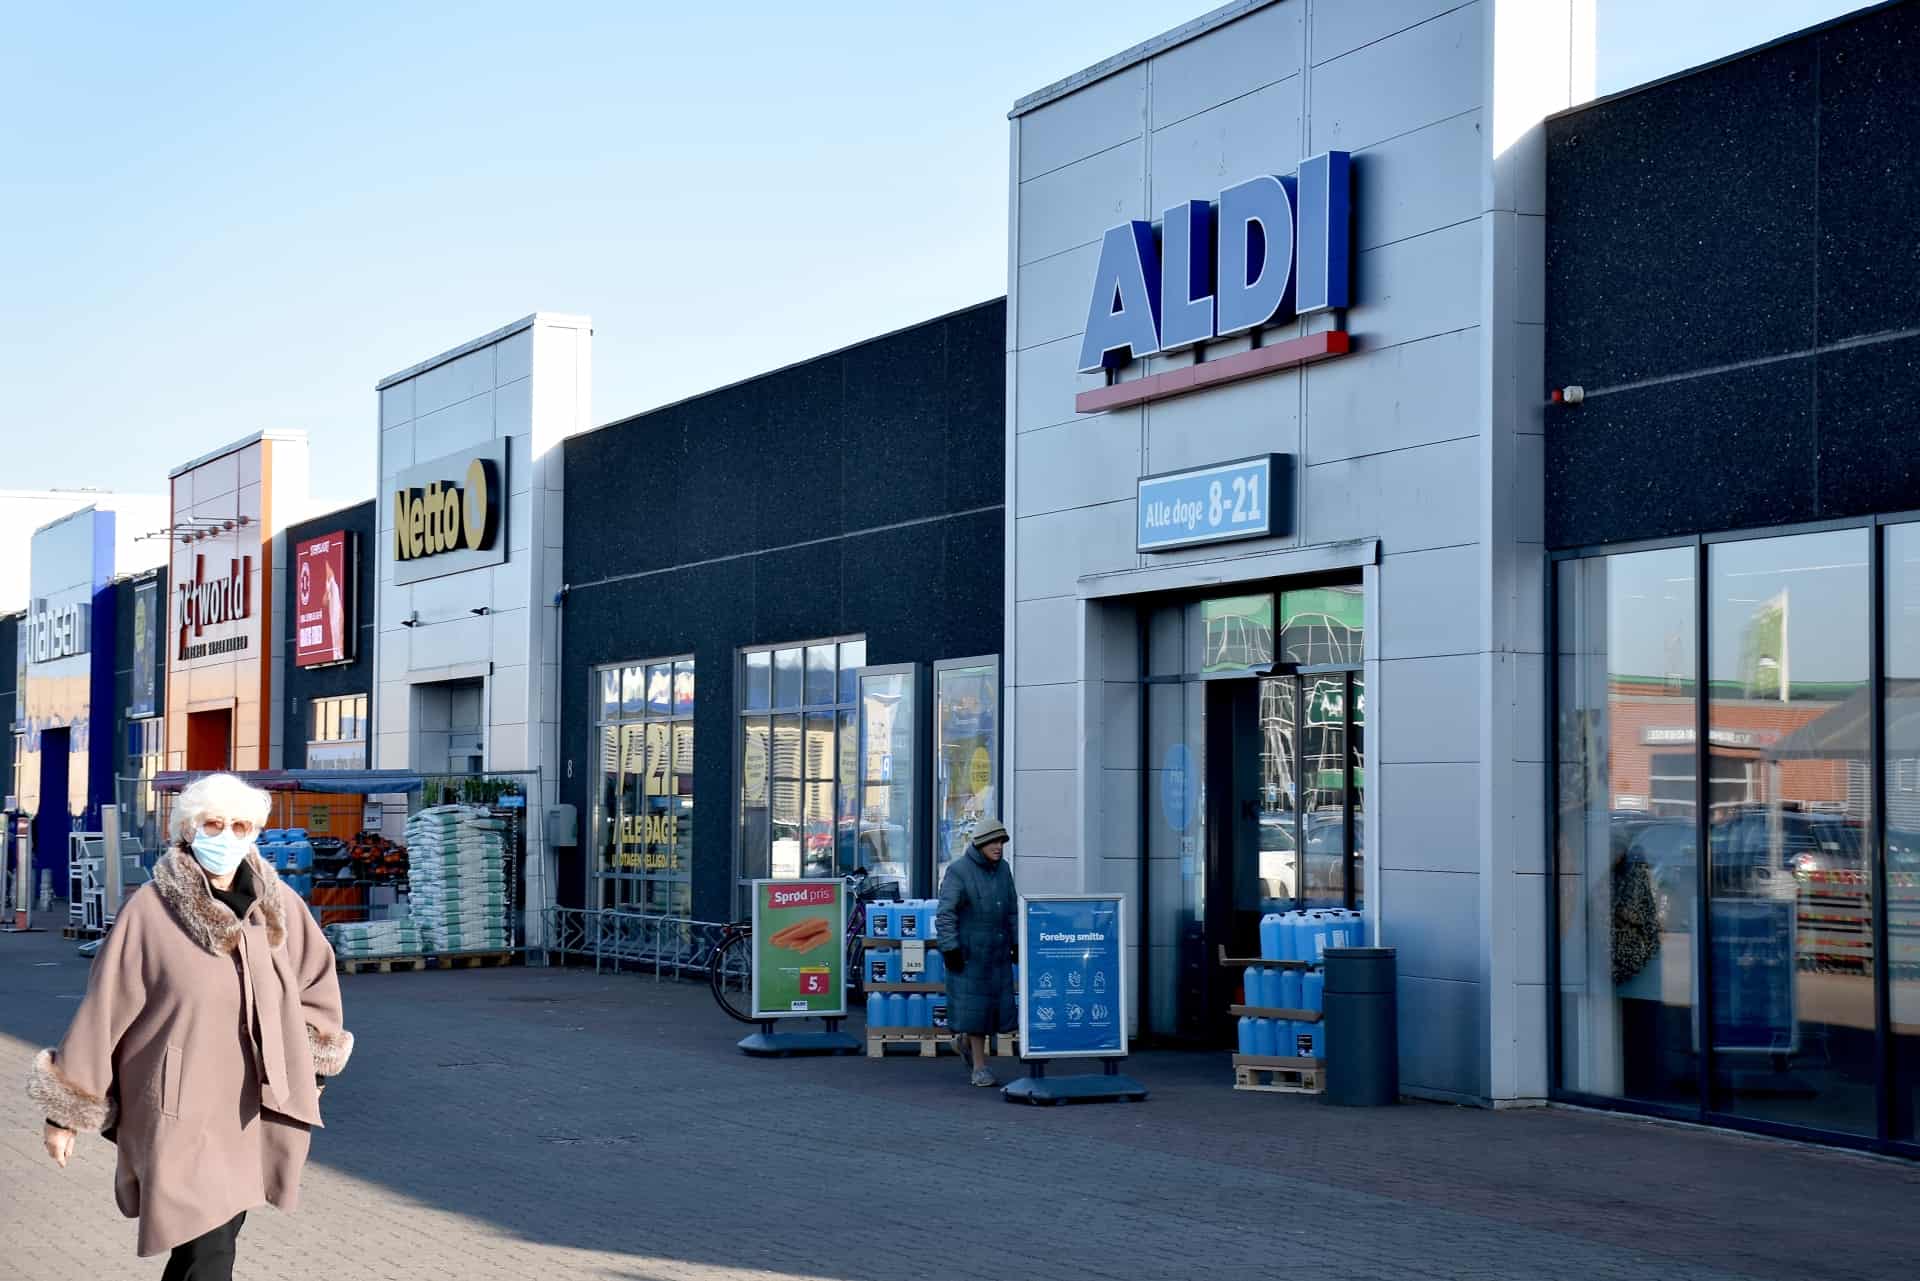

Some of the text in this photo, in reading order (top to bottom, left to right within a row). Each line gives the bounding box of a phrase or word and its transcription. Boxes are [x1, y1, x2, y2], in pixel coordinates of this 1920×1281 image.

[1078, 151, 1348, 374] ALDI
[394, 480, 460, 561] Netto
[1145, 473, 1261, 530] Alle dage 8-21
[567, 759, 573, 779] 8
[775, 888, 831, 904] Sprød pris
[1039, 932, 1105, 943] Forebyg smitte
